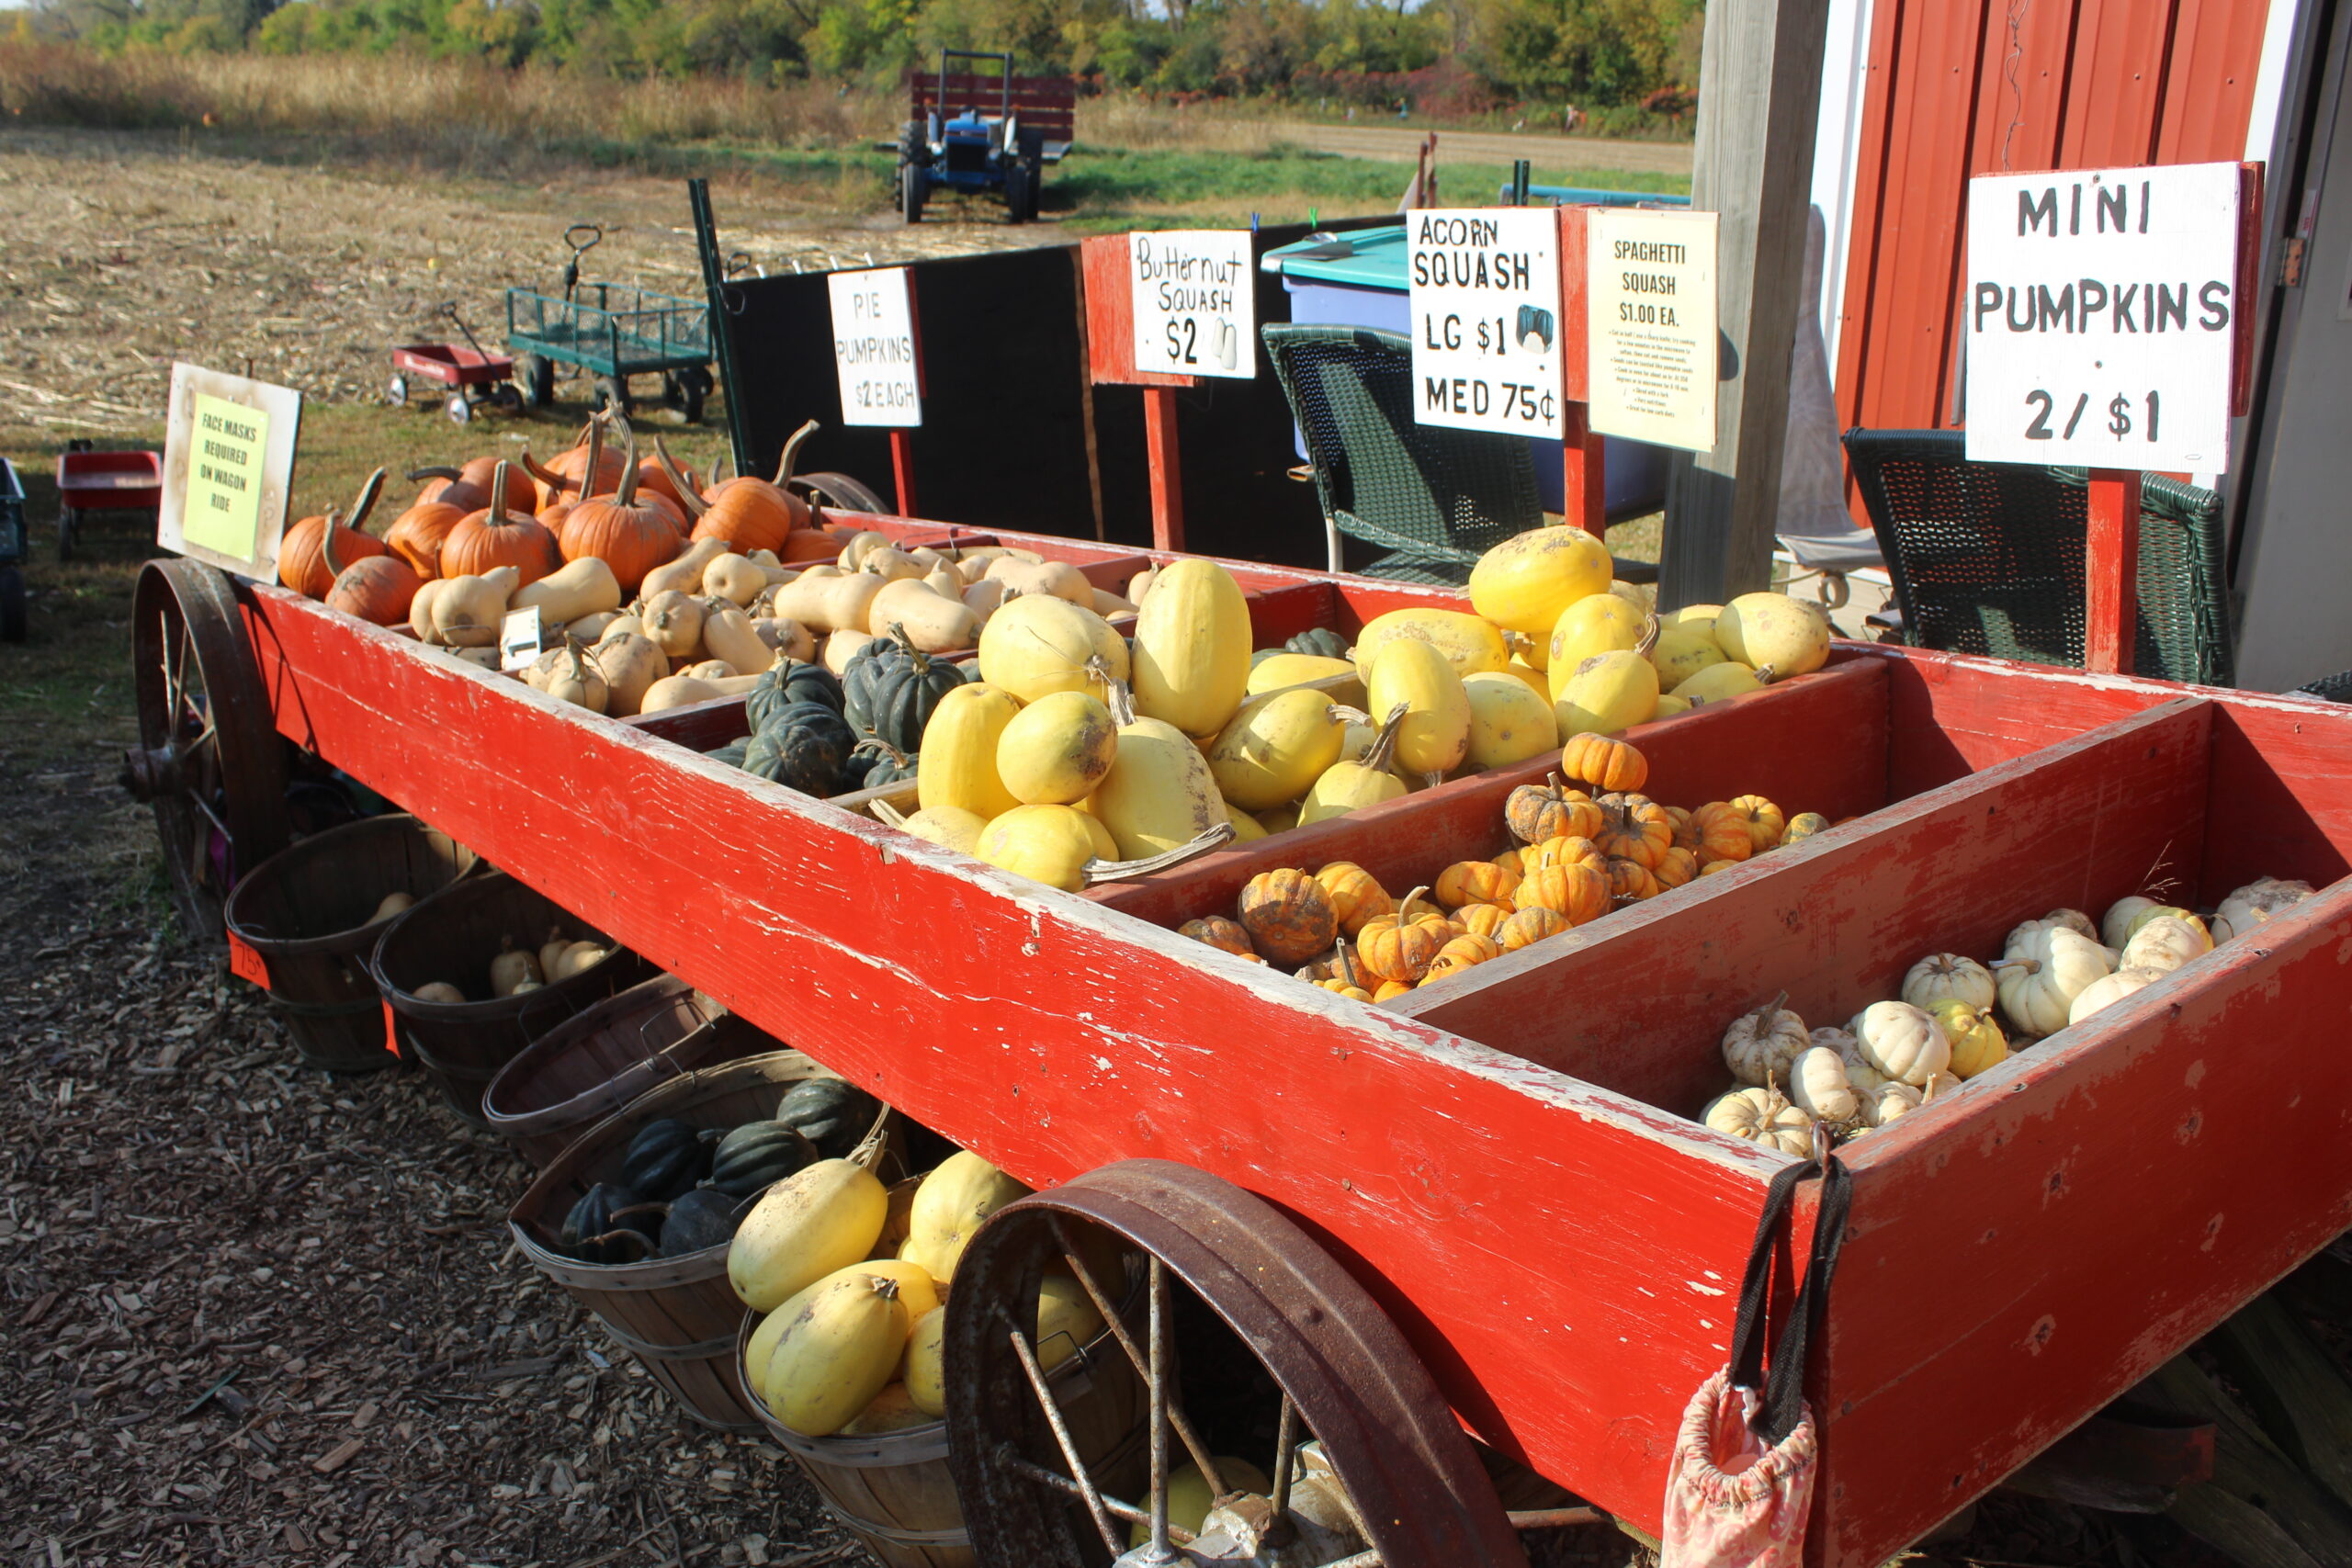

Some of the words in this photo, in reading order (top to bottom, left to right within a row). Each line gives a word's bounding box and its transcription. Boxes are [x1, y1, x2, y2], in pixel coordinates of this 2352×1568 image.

[2018, 180, 2150, 238] MINI
[1419, 215, 1498, 247] ACORN
[1137, 236, 1243, 287] Butternut
[1614, 240, 1686, 265] SPAGHETTI
[1414, 251, 1530, 291] SQUASH
[1623, 272, 1676, 295] SQUASH
[854, 292, 882, 319] PIE
[1158, 280, 1233, 313] SQUASH
[1974, 278, 2230, 333] PUMPKINS
[1620, 301, 1656, 324] $1.00
[1659, 307, 1679, 327] EA.
[1166, 316, 1198, 365] $2
[1426, 313, 1462, 351] LG
[1477, 317, 1506, 355] $1
[836, 336, 911, 365] PUMPKINS
[855, 380, 872, 408] $2
[1425, 376, 1489, 416] MED
[1501, 381, 1555, 426] 75¢
[201, 412, 223, 432] FACE
[223, 419, 257, 443] MASKS
[204, 440, 248, 466] REQUIRED
[200, 463, 212, 481] ON
[214, 468, 247, 492] WAGON
[210, 492, 231, 513] RIDE
